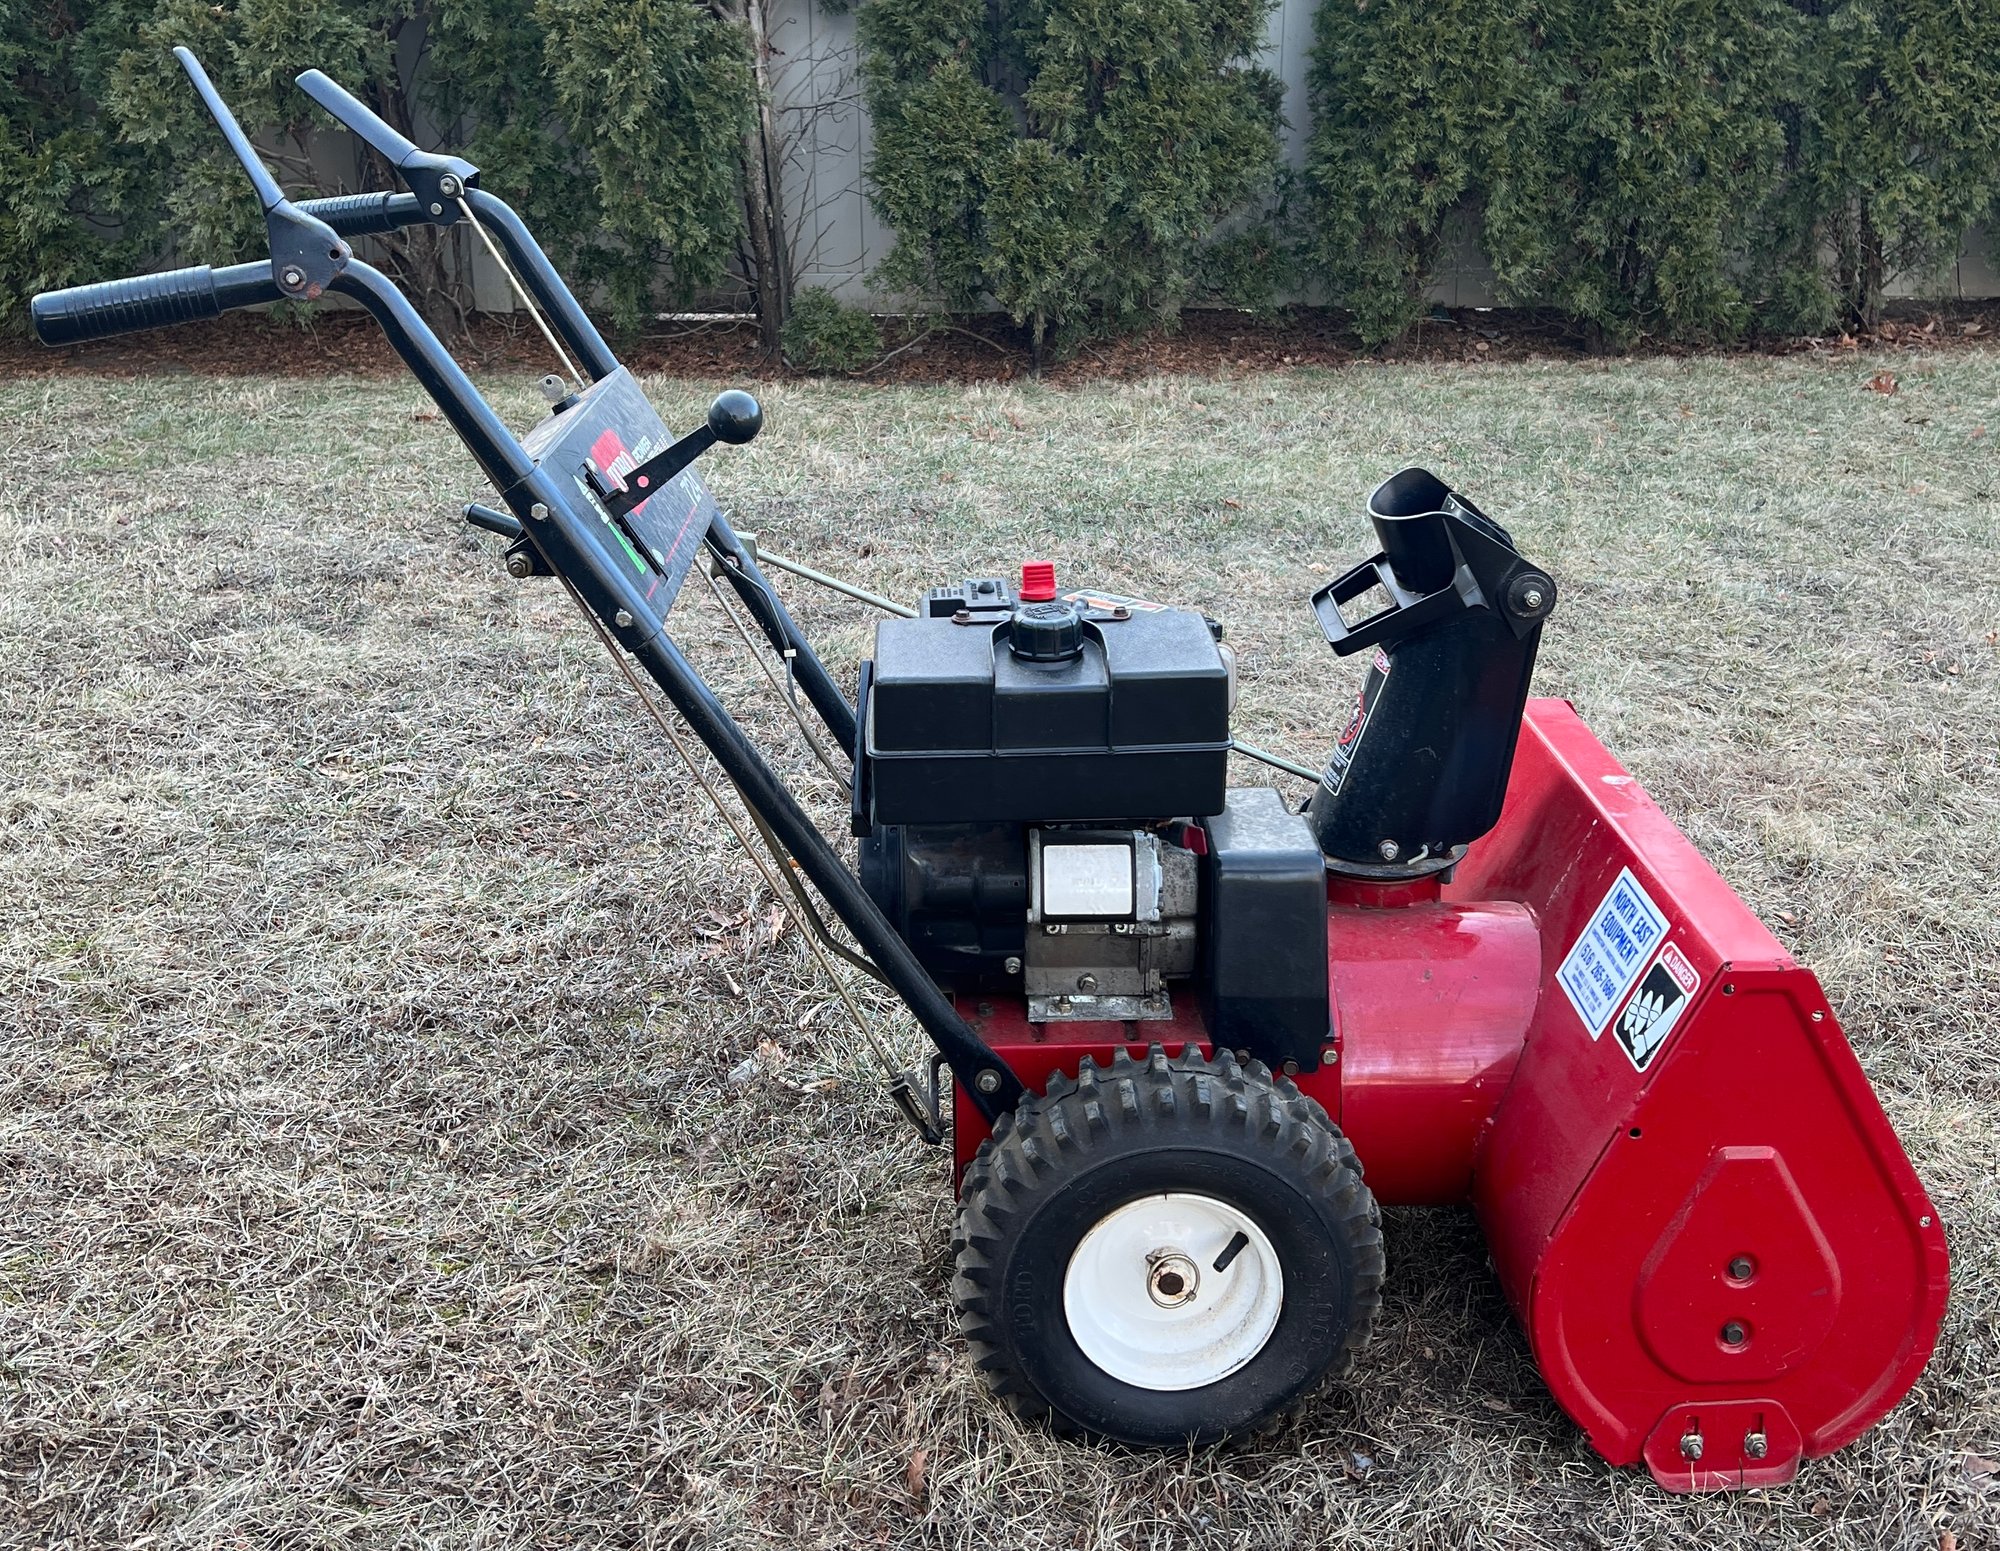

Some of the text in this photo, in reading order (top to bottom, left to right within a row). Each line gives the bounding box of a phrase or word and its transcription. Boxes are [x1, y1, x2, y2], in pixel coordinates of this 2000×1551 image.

[680, 470, 704, 507] 724
[1601, 910, 1639, 967] EQUIPMENT
[1612, 888, 1655, 947] NORTH EAST
[1579, 943, 1596, 970] (516)
[1591, 961, 1617, 1001] 265-7660
[1670, 955, 1695, 991] DANGER
